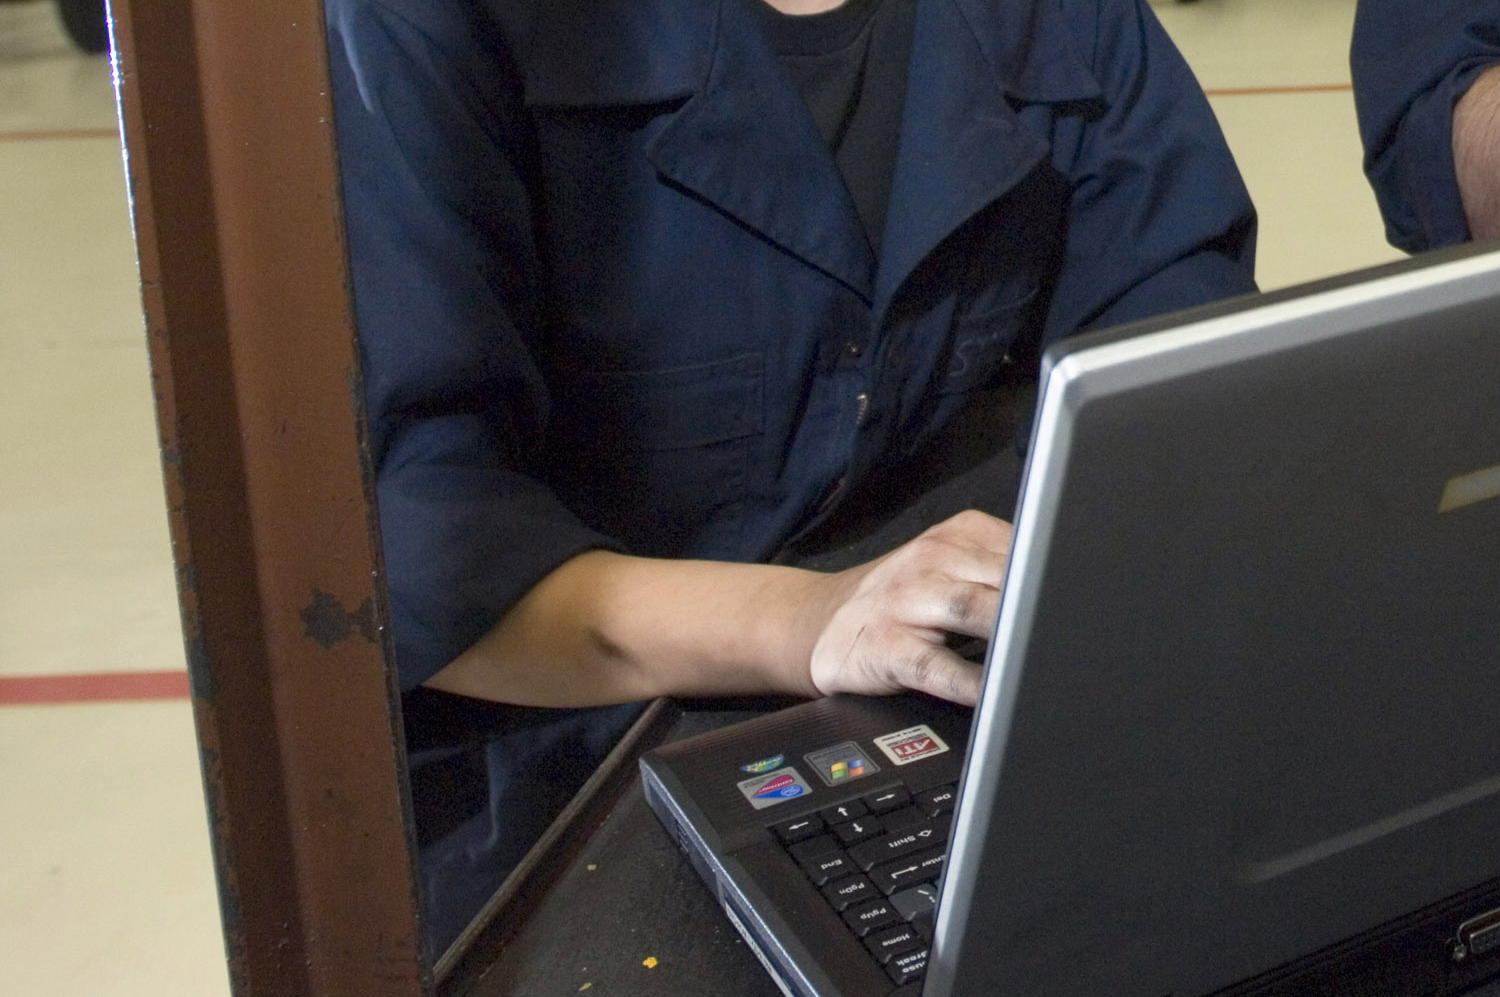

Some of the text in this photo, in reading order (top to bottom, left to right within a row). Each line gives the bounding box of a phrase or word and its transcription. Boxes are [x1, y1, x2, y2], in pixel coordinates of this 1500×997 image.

[897, 738, 932, 755] ATI
[933, 793, 951, 803] Del
[888, 835, 916, 848] Shift
[820, 859, 843, 870] End
[838, 882, 865, 895] PgDn
[860, 907, 887, 920] PgUp
[882, 933, 910, 946] Home
[902, 961, 926, 973] use
